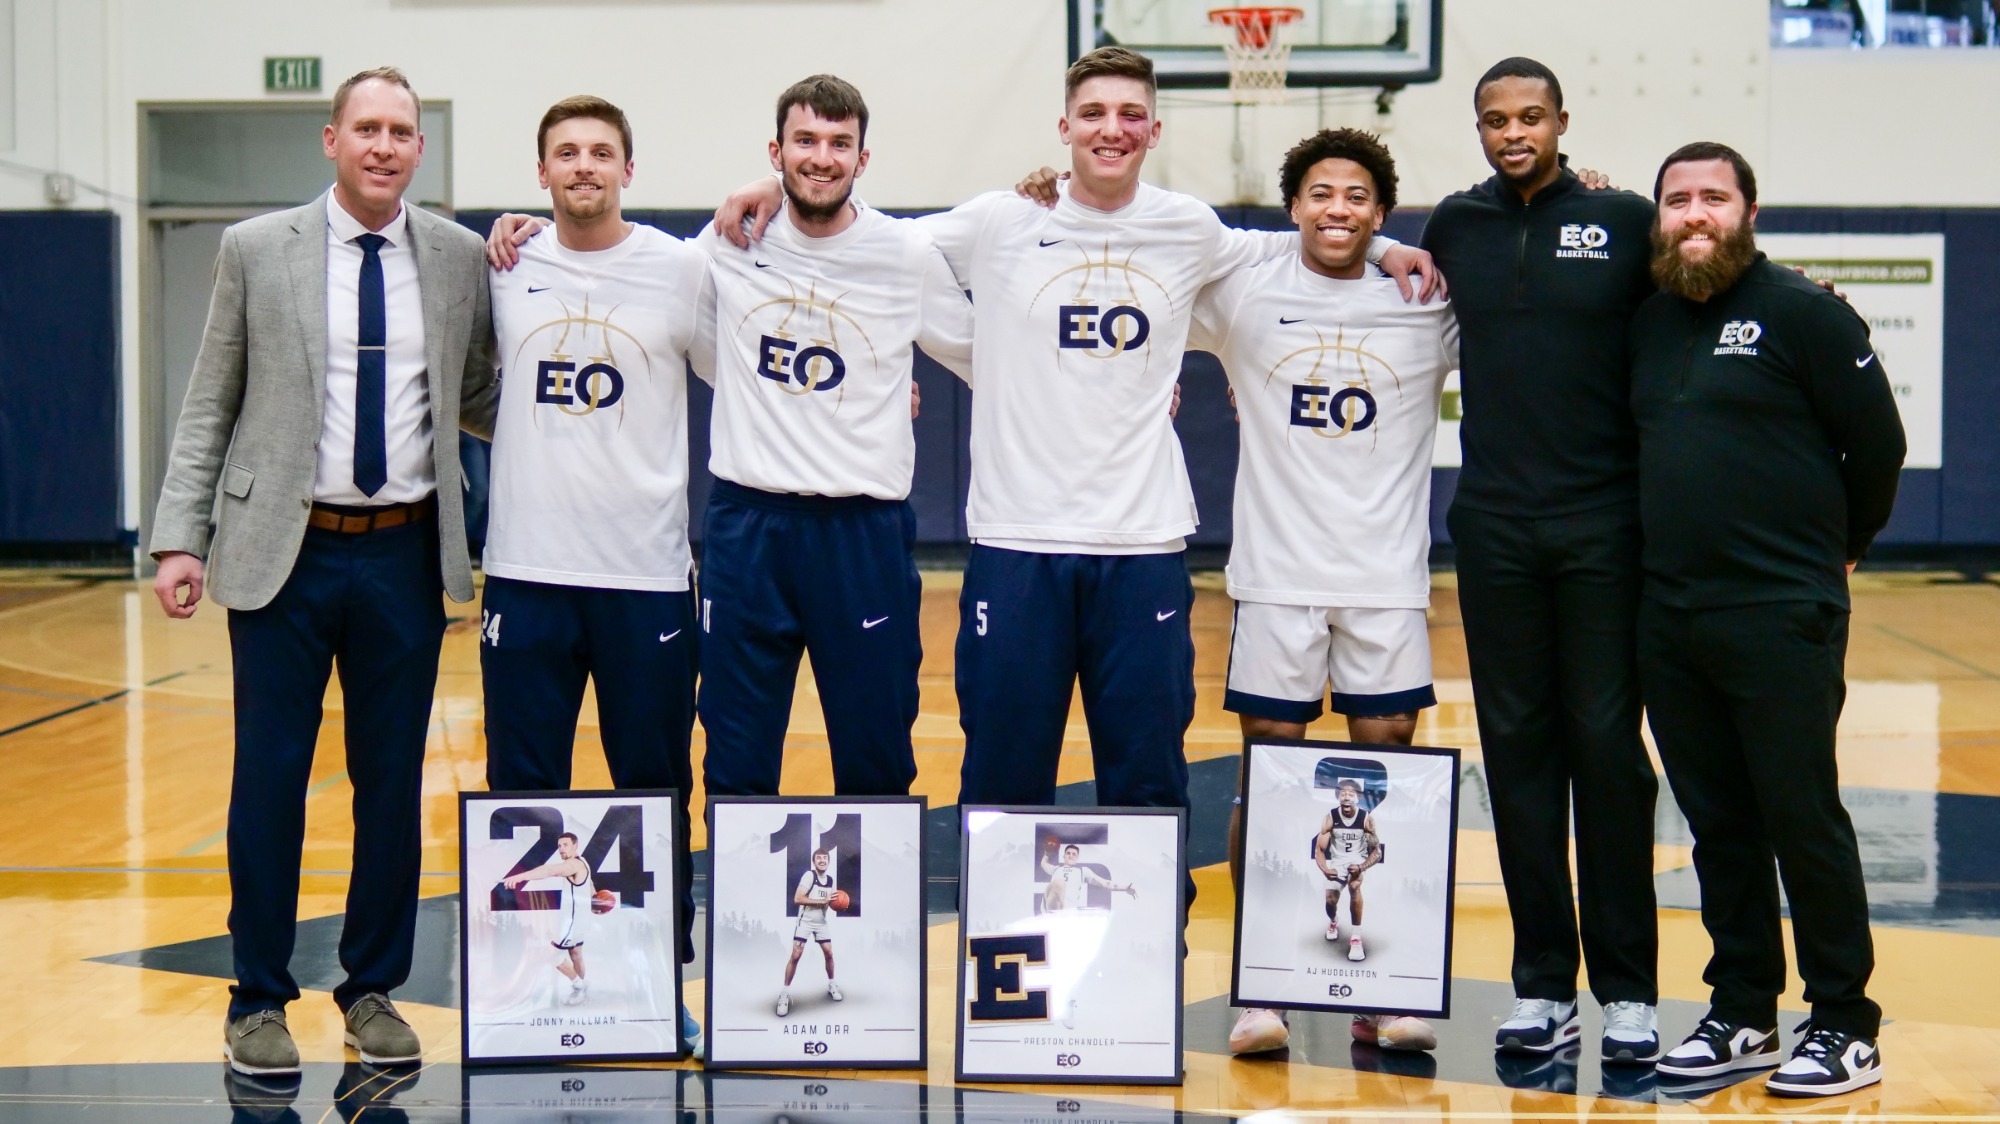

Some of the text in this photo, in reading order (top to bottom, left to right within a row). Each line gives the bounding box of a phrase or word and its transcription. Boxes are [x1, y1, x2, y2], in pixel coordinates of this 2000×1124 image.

[275, 60, 312, 89] EXIT
[1556, 249, 1609, 259] BASKETBALL
[1713, 347, 1757, 356] BASKETBALL
[977, 601, 988, 636] 5
[1346, 843, 1352, 852] 2
[490, 805, 654, 911] 24
[770, 813, 861, 917] 11
[967, 933, 1050, 1024] E
[1307, 967, 1377, 979] AJ HUDDLESTON
[530, 1016, 616, 1027] JONNY HILLMAN
[784, 1025, 849, 1035] ADAM ORR
[1024, 1037, 1115, 1047] PRESTON CHANDLER
